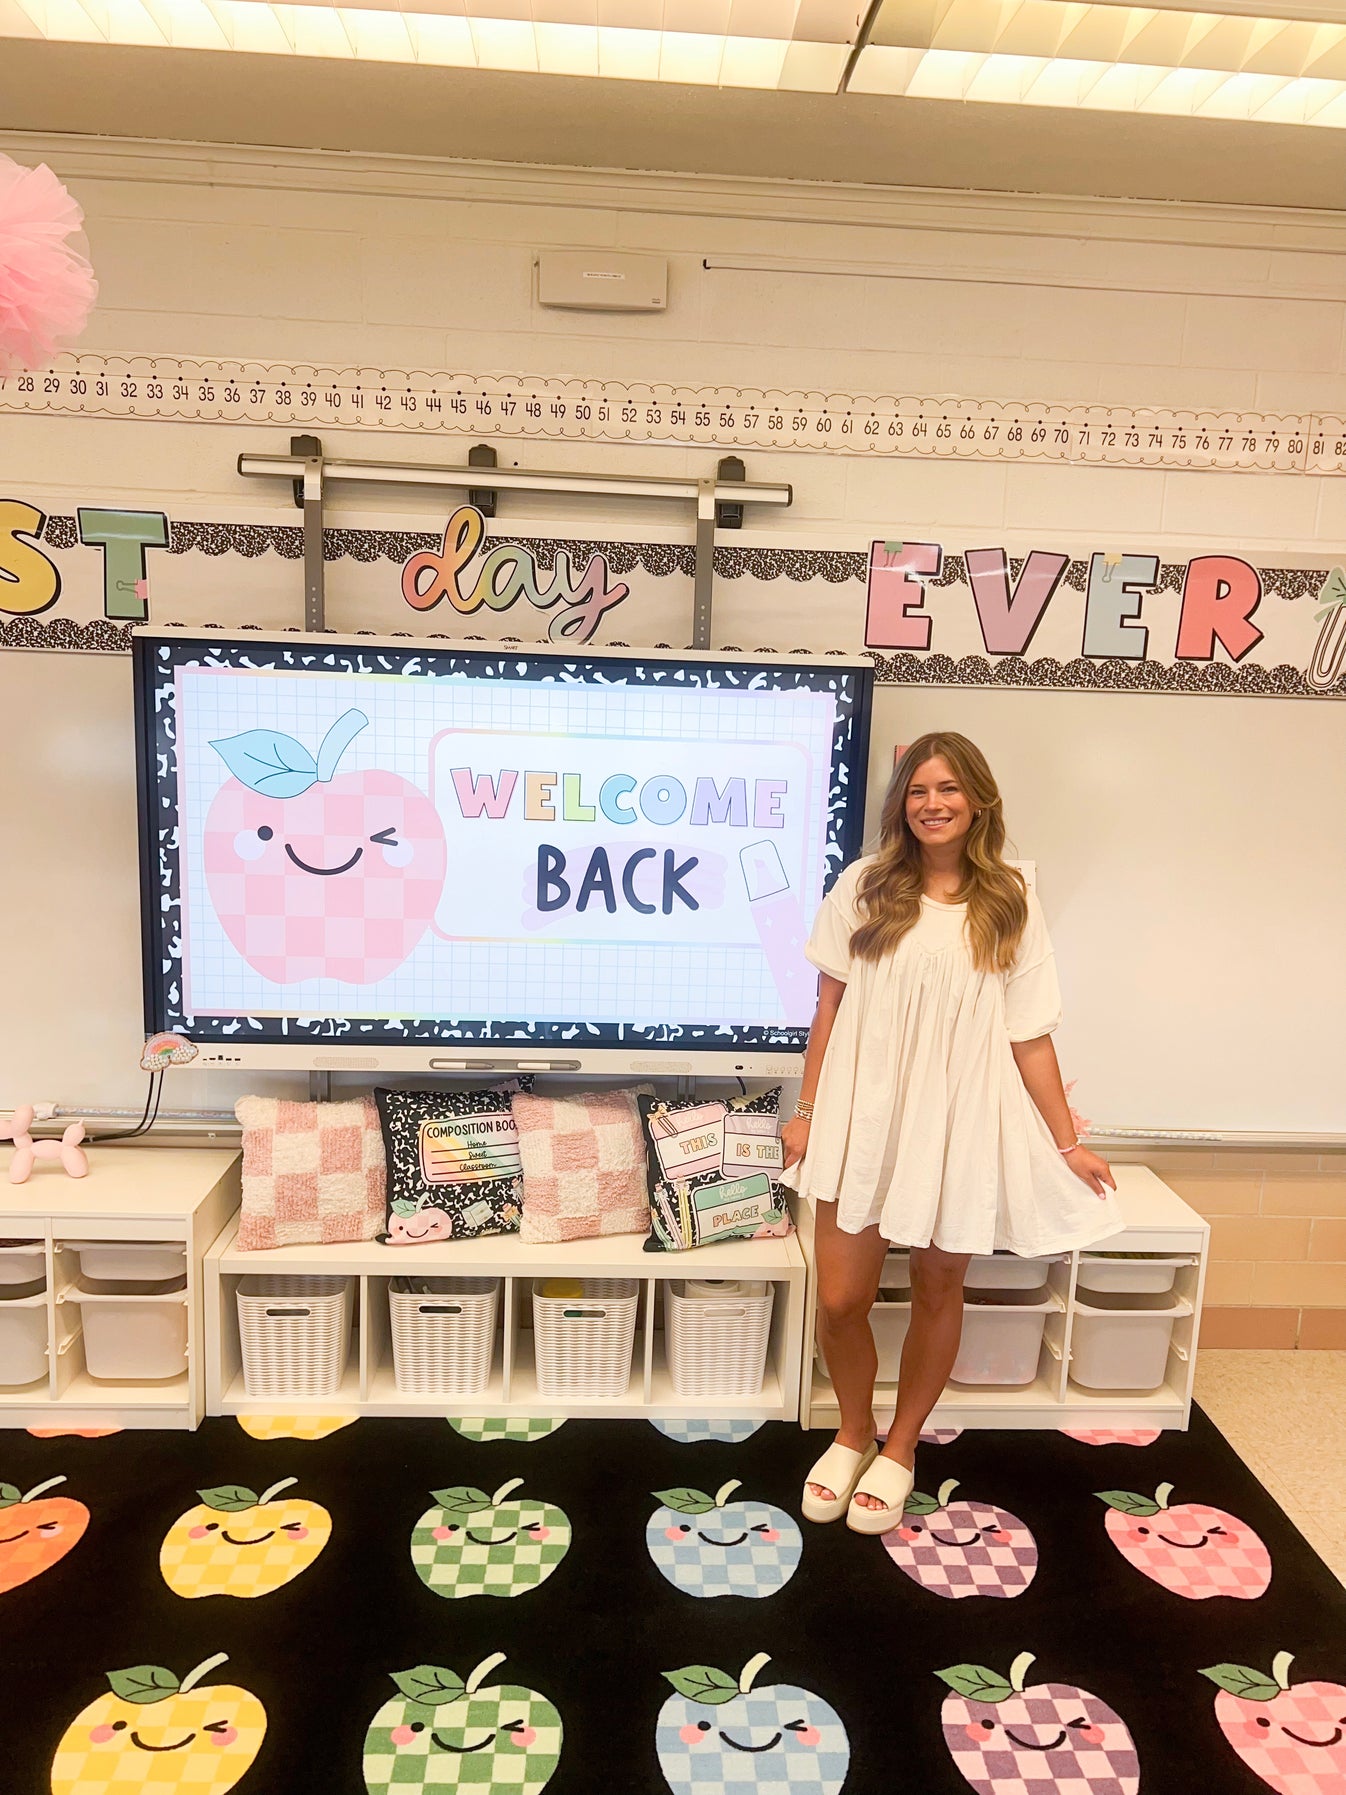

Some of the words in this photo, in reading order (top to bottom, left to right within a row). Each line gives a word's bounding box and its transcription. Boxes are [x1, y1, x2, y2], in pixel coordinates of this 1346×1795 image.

[17, 376, 35, 393] 28
[43, 377, 61, 394] 29
[69, 378, 87, 395] 30
[95, 380, 109, 397] 31
[120, 381, 138, 398] 32
[146, 383, 164, 400] 33
[172, 384, 190, 401] 34
[198, 385, 216, 402] 35
[223, 386, 241, 404] 36
[249, 388, 267, 405] 37
[275, 389, 292, 406] 38
[300, 390, 318, 407] 39
[324, 392, 342, 408] 40
[351, 393, 364, 409] 41
[375, 394, 392, 411] 42
[400, 395, 417, 412] 43
[425, 397, 443, 413] 44
[450, 398, 468, 415] 45
[475, 399, 492, 416] 46
[500, 400, 517, 417] 47
[525, 401, 542, 418] 48
[550, 403, 567, 419] 49
[574, 404, 592, 421] 50
[597, 406, 610, 422] 51
[621, 407, 638, 423] 52
[645, 408, 662, 425] 53
[670, 409, 687, 426] 54
[694, 411, 711, 427] 55
[719, 412, 735, 428] 56
[743, 413, 760, 429] 57
[767, 415, 784, 431] 58
[791, 416, 808, 432] 59
[815, 417, 832, 433] 60
[841, 418, 854, 434] 61
[863, 419, 880, 436] 62
[887, 421, 904, 437] 63
[911, 422, 928, 438] 64
[935, 423, 952, 439] 65
[959, 424, 976, 440] 66
[983, 425, 1000, 441] 67
[1007, 426, 1023, 442] 68
[1030, 427, 1047, 443] 69
[1053, 428, 1070, 444] 70
[1078, 430, 1091, 446] 71
[1100, 431, 1117, 447] 72
[1124, 432, 1140, 448] 73
[1148, 433, 1163, 449] 74
[1171, 434, 1187, 450] 75
[1195, 435, 1210, 451] 76
[1218, 436, 1234, 452] 77
[1241, 437, 1257, 453] 78
[1264, 438, 1280, 453] 79
[1287, 438, 1304, 455] 80
[1312, 440, 1325, 455] 81
[401, 506, 630, 645] day
[864, 540, 1265, 662] EVER
[450, 766, 788, 829] WELCOME
[536, 843, 700, 915] BACK
[769, 1029, 798, 1037] Schoolgirl
[426, 1122, 494, 1139] COMPOSITION
[495, 1119, 518, 1132] BOO
[466, 1140, 487, 1149] Home
[679, 1132, 718, 1155] THIS
[736, 1143, 751, 1157] IS
[756, 1144, 780, 1160] THE
[468, 1150, 488, 1160] Sweet
[459, 1162, 497, 1171] Classroom
[719, 1183, 748, 1199] hello
[712, 1205, 760, 1228] PLACE
